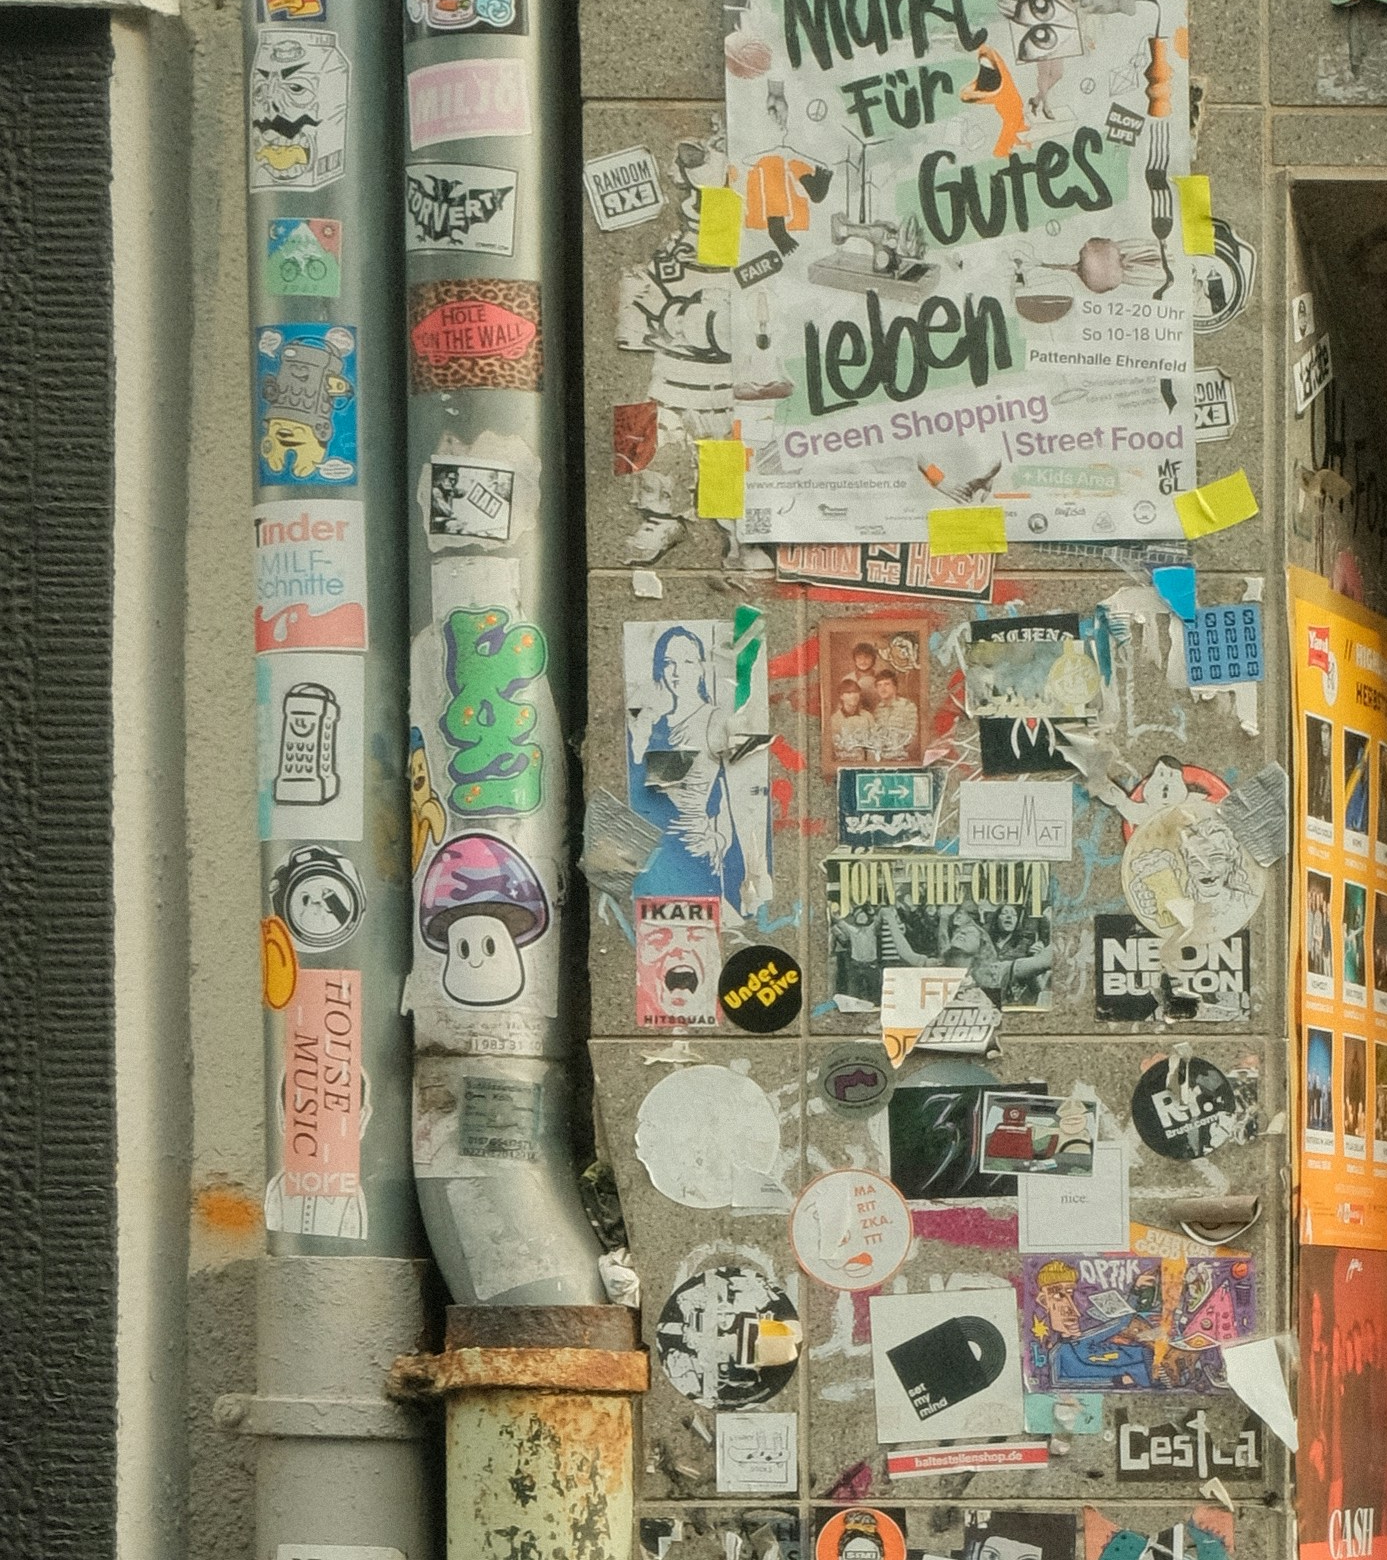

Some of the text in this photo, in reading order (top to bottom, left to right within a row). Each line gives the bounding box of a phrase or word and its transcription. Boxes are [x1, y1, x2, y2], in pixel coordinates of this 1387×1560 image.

[842, 66, 954, 137] Für
[1108, 110, 1143, 129] SLOW
[1109, 126, 1135, 142] LIFE
[918, 128, 1113, 245] Gutes
[739, 259, 774, 285] FAIR
[440, 307, 486, 326] HOLE
[1083, 302, 1185, 319] So 12-20 Uhr
[443, 330, 473, 351] THE
[476, 324, 522, 347] WALL
[1029, 350, 1187, 372] Pattenhalle Ehrenfeld
[784, 395, 1049, 458] Green Shopping
[1112, 426, 1183, 451] Food
[470, 486, 500, 514] RAH
[261, 549, 332, 576] MILF-
[838, 860, 1049, 918] JOIN THE CULT
[640, 904, 714, 920] IKARI
[723, 959, 779, 1010] Under
[759, 967, 800, 1007] Dive
[645, 1015, 715, 1025] HITSQUAD
[323, 979, 352, 1114] HOUSE
[294, 1034, 318, 1158] MUSIC
[1061, 1191, 1089, 1205] nice.
[909, 1383, 927, 1401] set
[914, 1393, 931, 1411] my
[920, 1398, 948, 1418] mind
[915, 1449, 1023, 1469] haltestellenshop.de
[1328, 1508, 1374, 1560] CASH
